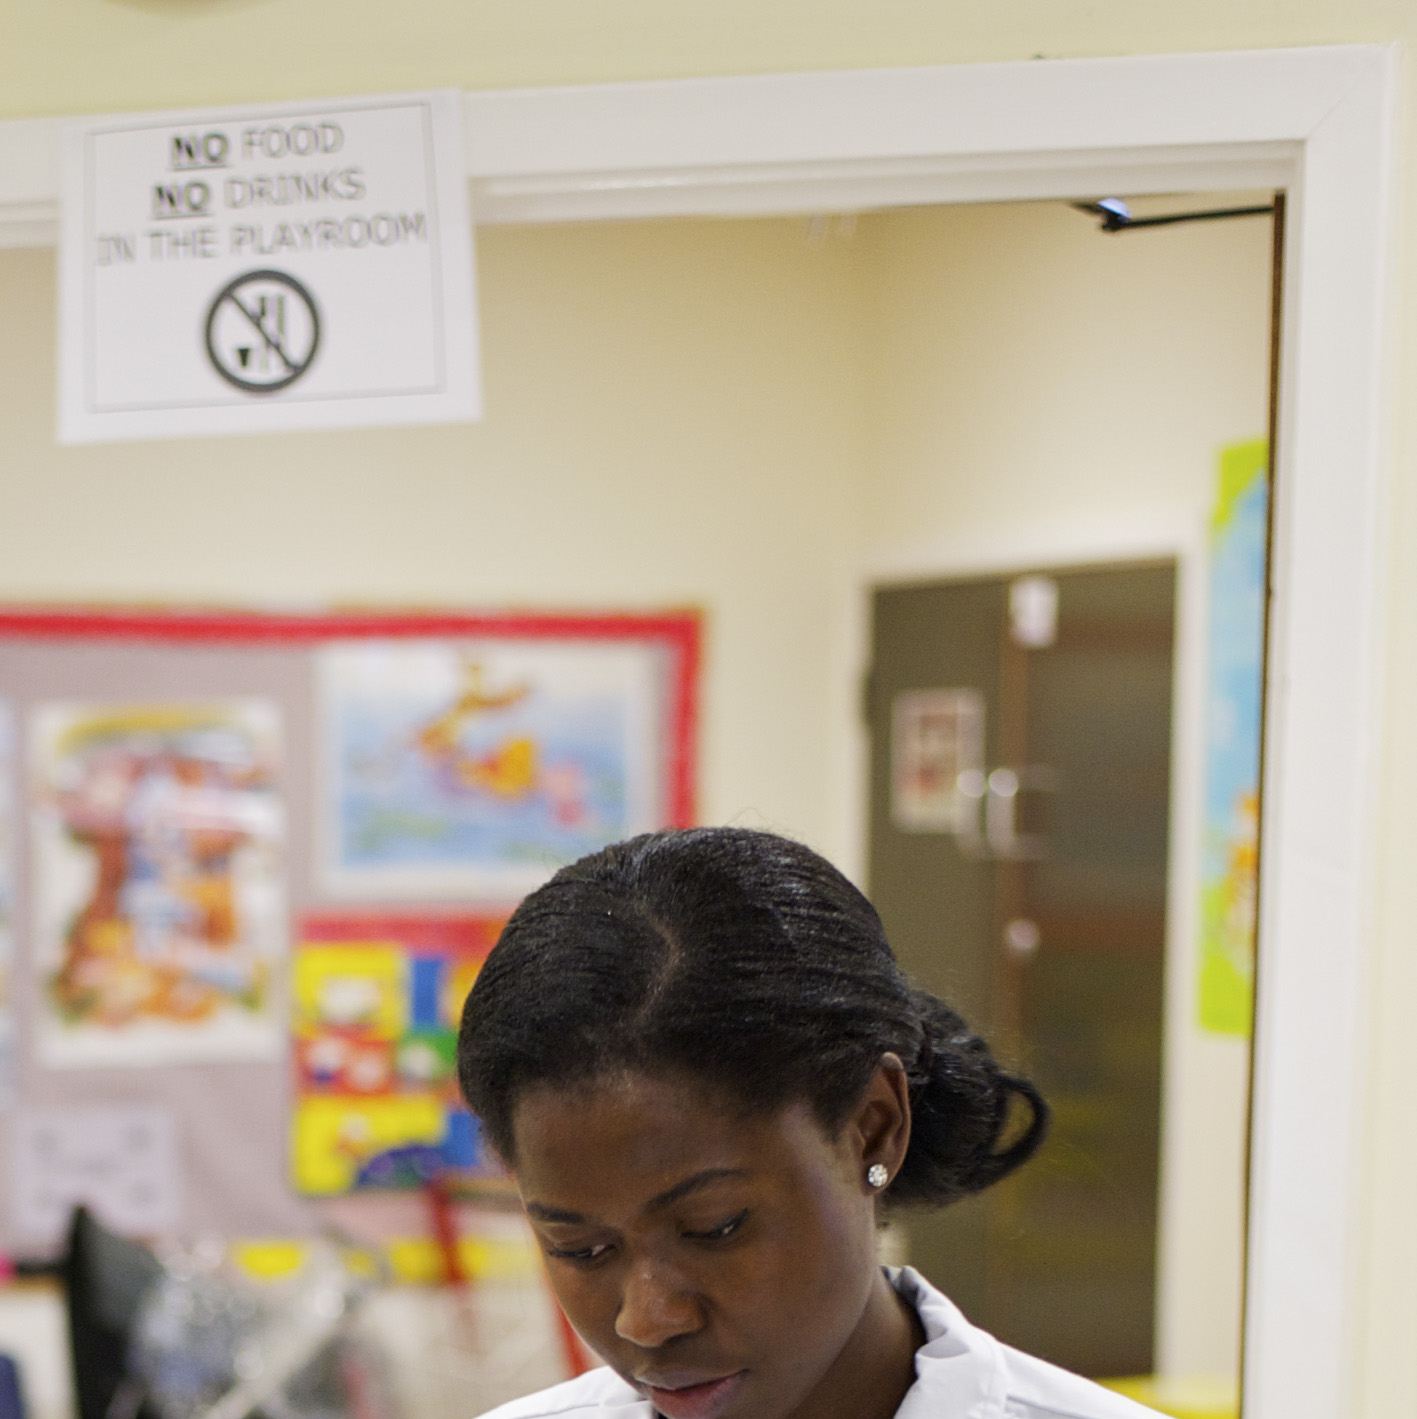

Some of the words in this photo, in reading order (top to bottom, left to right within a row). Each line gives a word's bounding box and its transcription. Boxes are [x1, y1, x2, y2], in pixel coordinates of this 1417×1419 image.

[171, 132, 230, 170] NO
[242, 122, 345, 160] FOOD
[152, 180, 211, 219] NO
[224, 168, 367, 209] DRINKS
[96, 233, 136, 267] IN
[145, 226, 219, 261] THE
[230, 211, 427, 256] PLAYROOM
